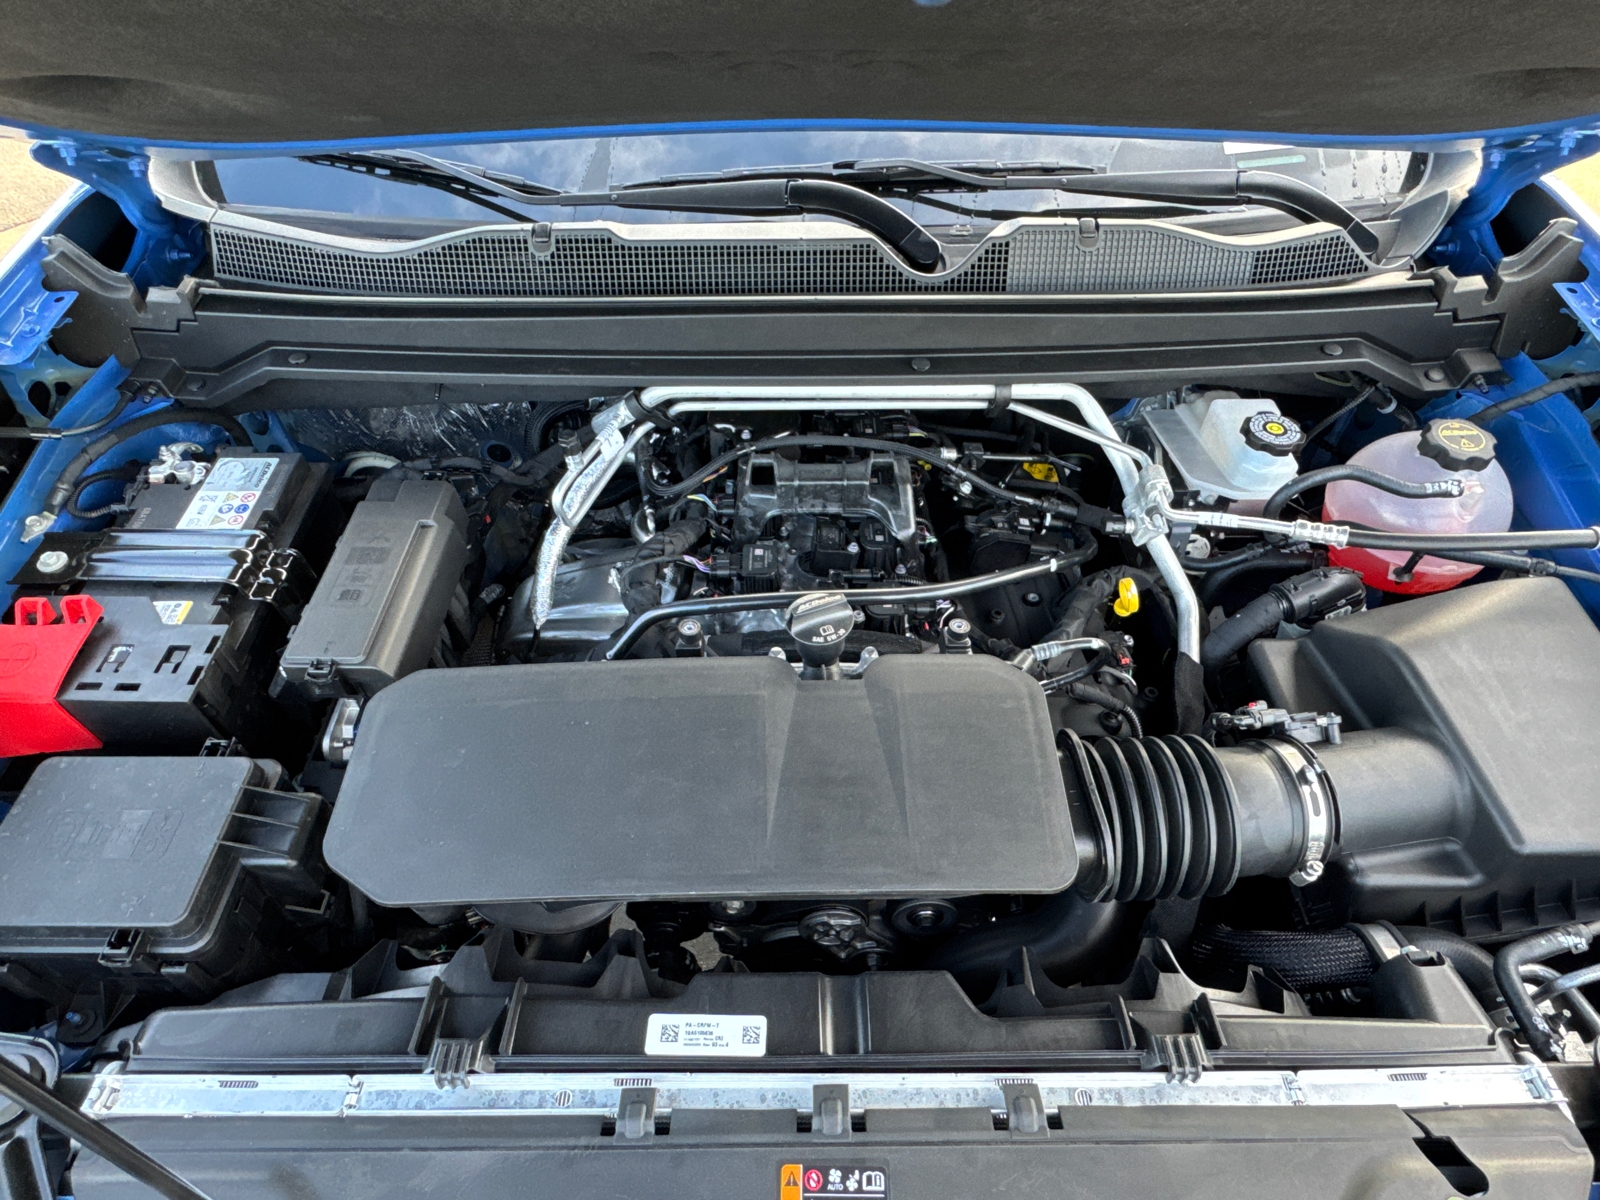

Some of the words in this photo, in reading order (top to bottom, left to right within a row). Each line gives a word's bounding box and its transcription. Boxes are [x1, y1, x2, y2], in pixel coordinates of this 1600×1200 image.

[255, 461, 272, 488] ACDelco
[796, 595, 842, 613] ACDelco
[827, 1183, 844, 1191] AUTO
